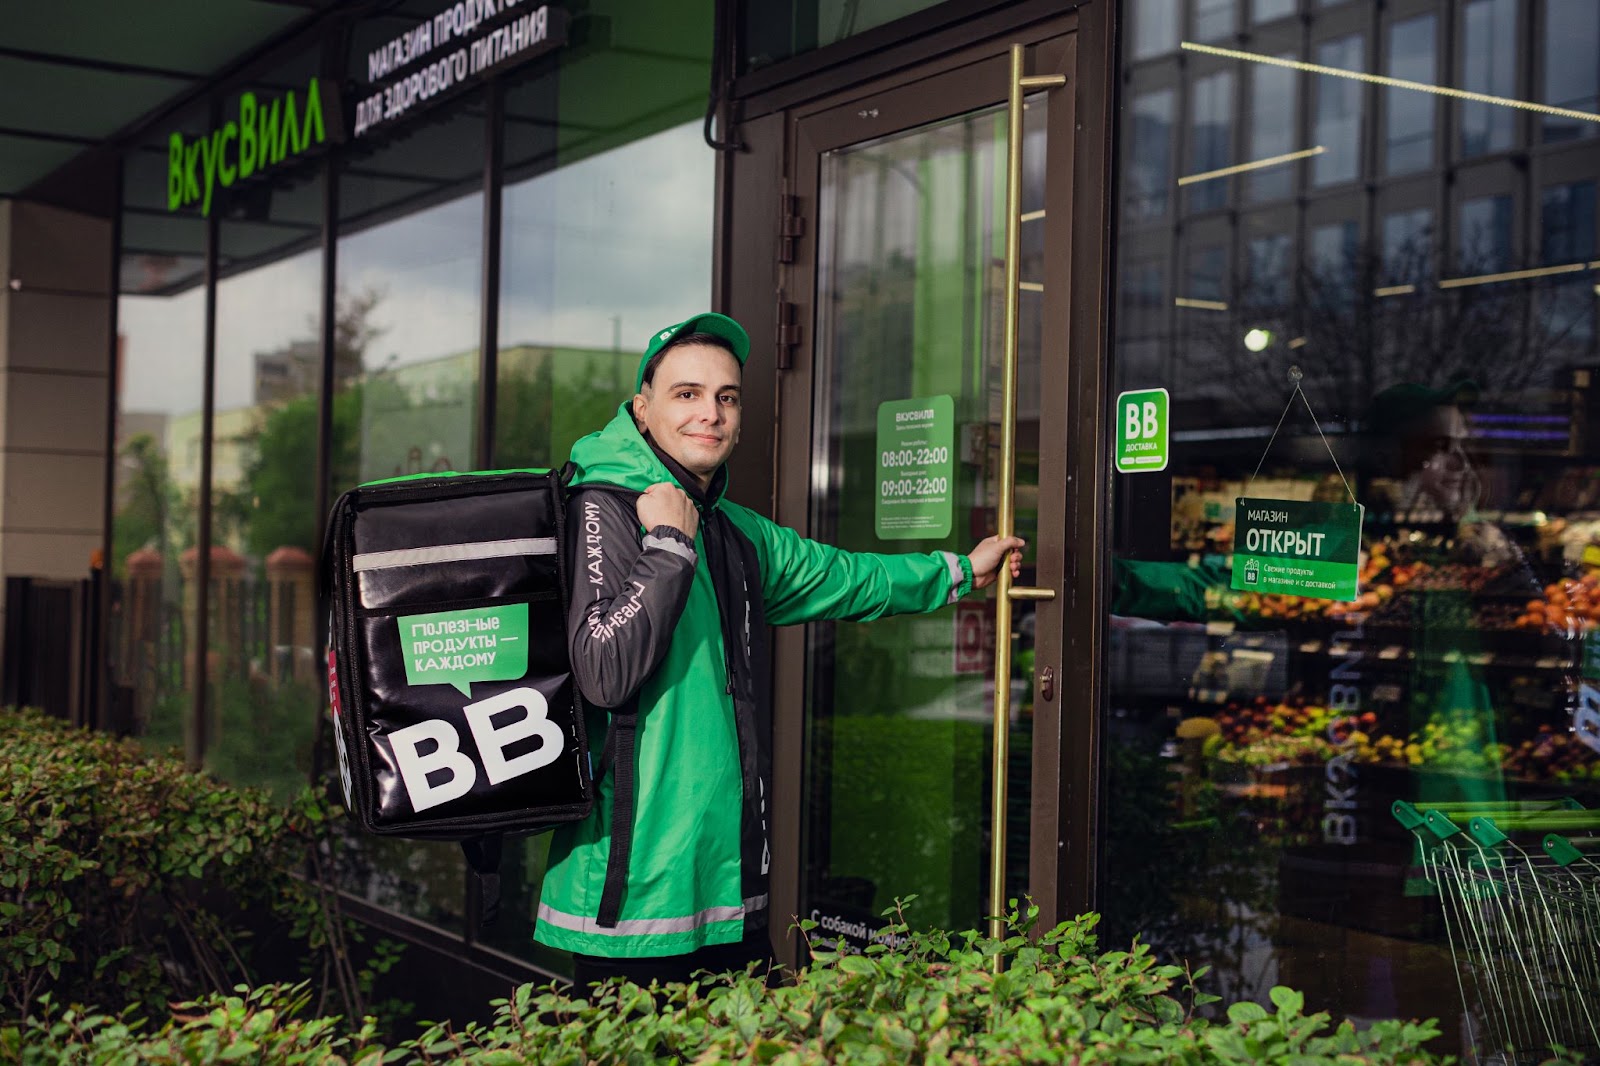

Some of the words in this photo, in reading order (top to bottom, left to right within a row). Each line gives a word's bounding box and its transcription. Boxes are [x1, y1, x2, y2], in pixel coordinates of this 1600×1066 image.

[367, 20, 433, 84] МАГАЗИН
[433, 0, 524, 47] ПРОДУК
[354, 92, 383, 138] ДЛЯ
[383, 48, 468, 120] ЗДОРОВОГО
[470, 5, 548, 75] ПИТАНИЯ
[1125, 402, 1158, 440] ВВ
[882, 447, 948, 468] 08:00-22:00
[1125, 443, 1158, 453] ДОСТАВКА
[881, 477, 947, 497] 09:00-22:00
[1247, 510, 1288, 523] МАГАЗИН
[585, 501, 603, 585] КАЖДОМУ
[1246, 528, 1325, 556] ОТКРЫТ
[1263, 564, 1285, 574] Свежие
[1286, 568, 1314, 577] продукты
[1268, 577, 1294, 586] магазине
[1304, 581, 1336, 590] доставкой
[413, 634, 497, 654] ПРОДУКТЫ
[415, 652, 497, 672] КАЖДОМУ
[387, 686, 565, 813] ВВ
[811, 909, 820, 923] С
[821, 915, 866, 939] собакой
